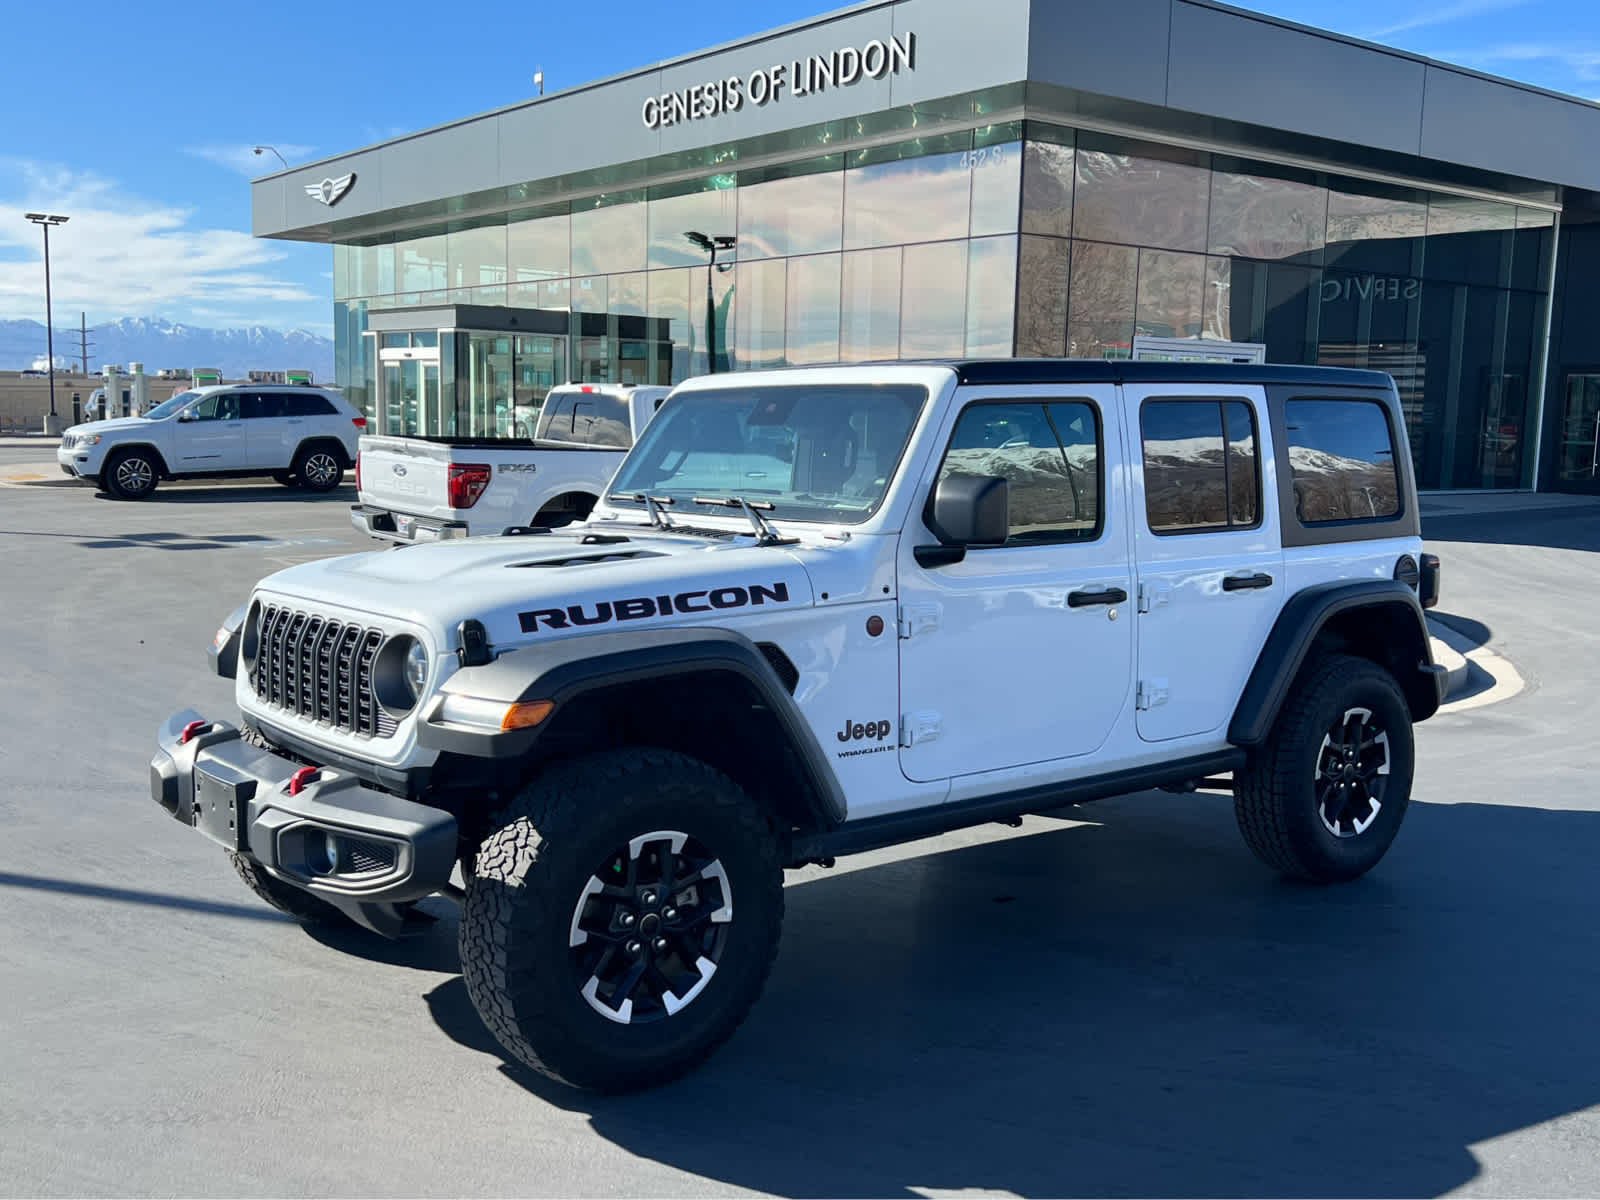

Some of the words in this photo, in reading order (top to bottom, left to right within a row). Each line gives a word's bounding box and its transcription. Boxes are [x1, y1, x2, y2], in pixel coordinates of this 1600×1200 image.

[642, 76, 743, 129] GENESIS
[747, 64, 786, 104] OF
[791, 31, 916, 98] LINDON
[959, 149, 986, 169] 452
[518, 582, 790, 634] RUBICON
[837, 719, 891, 742] Jeep
